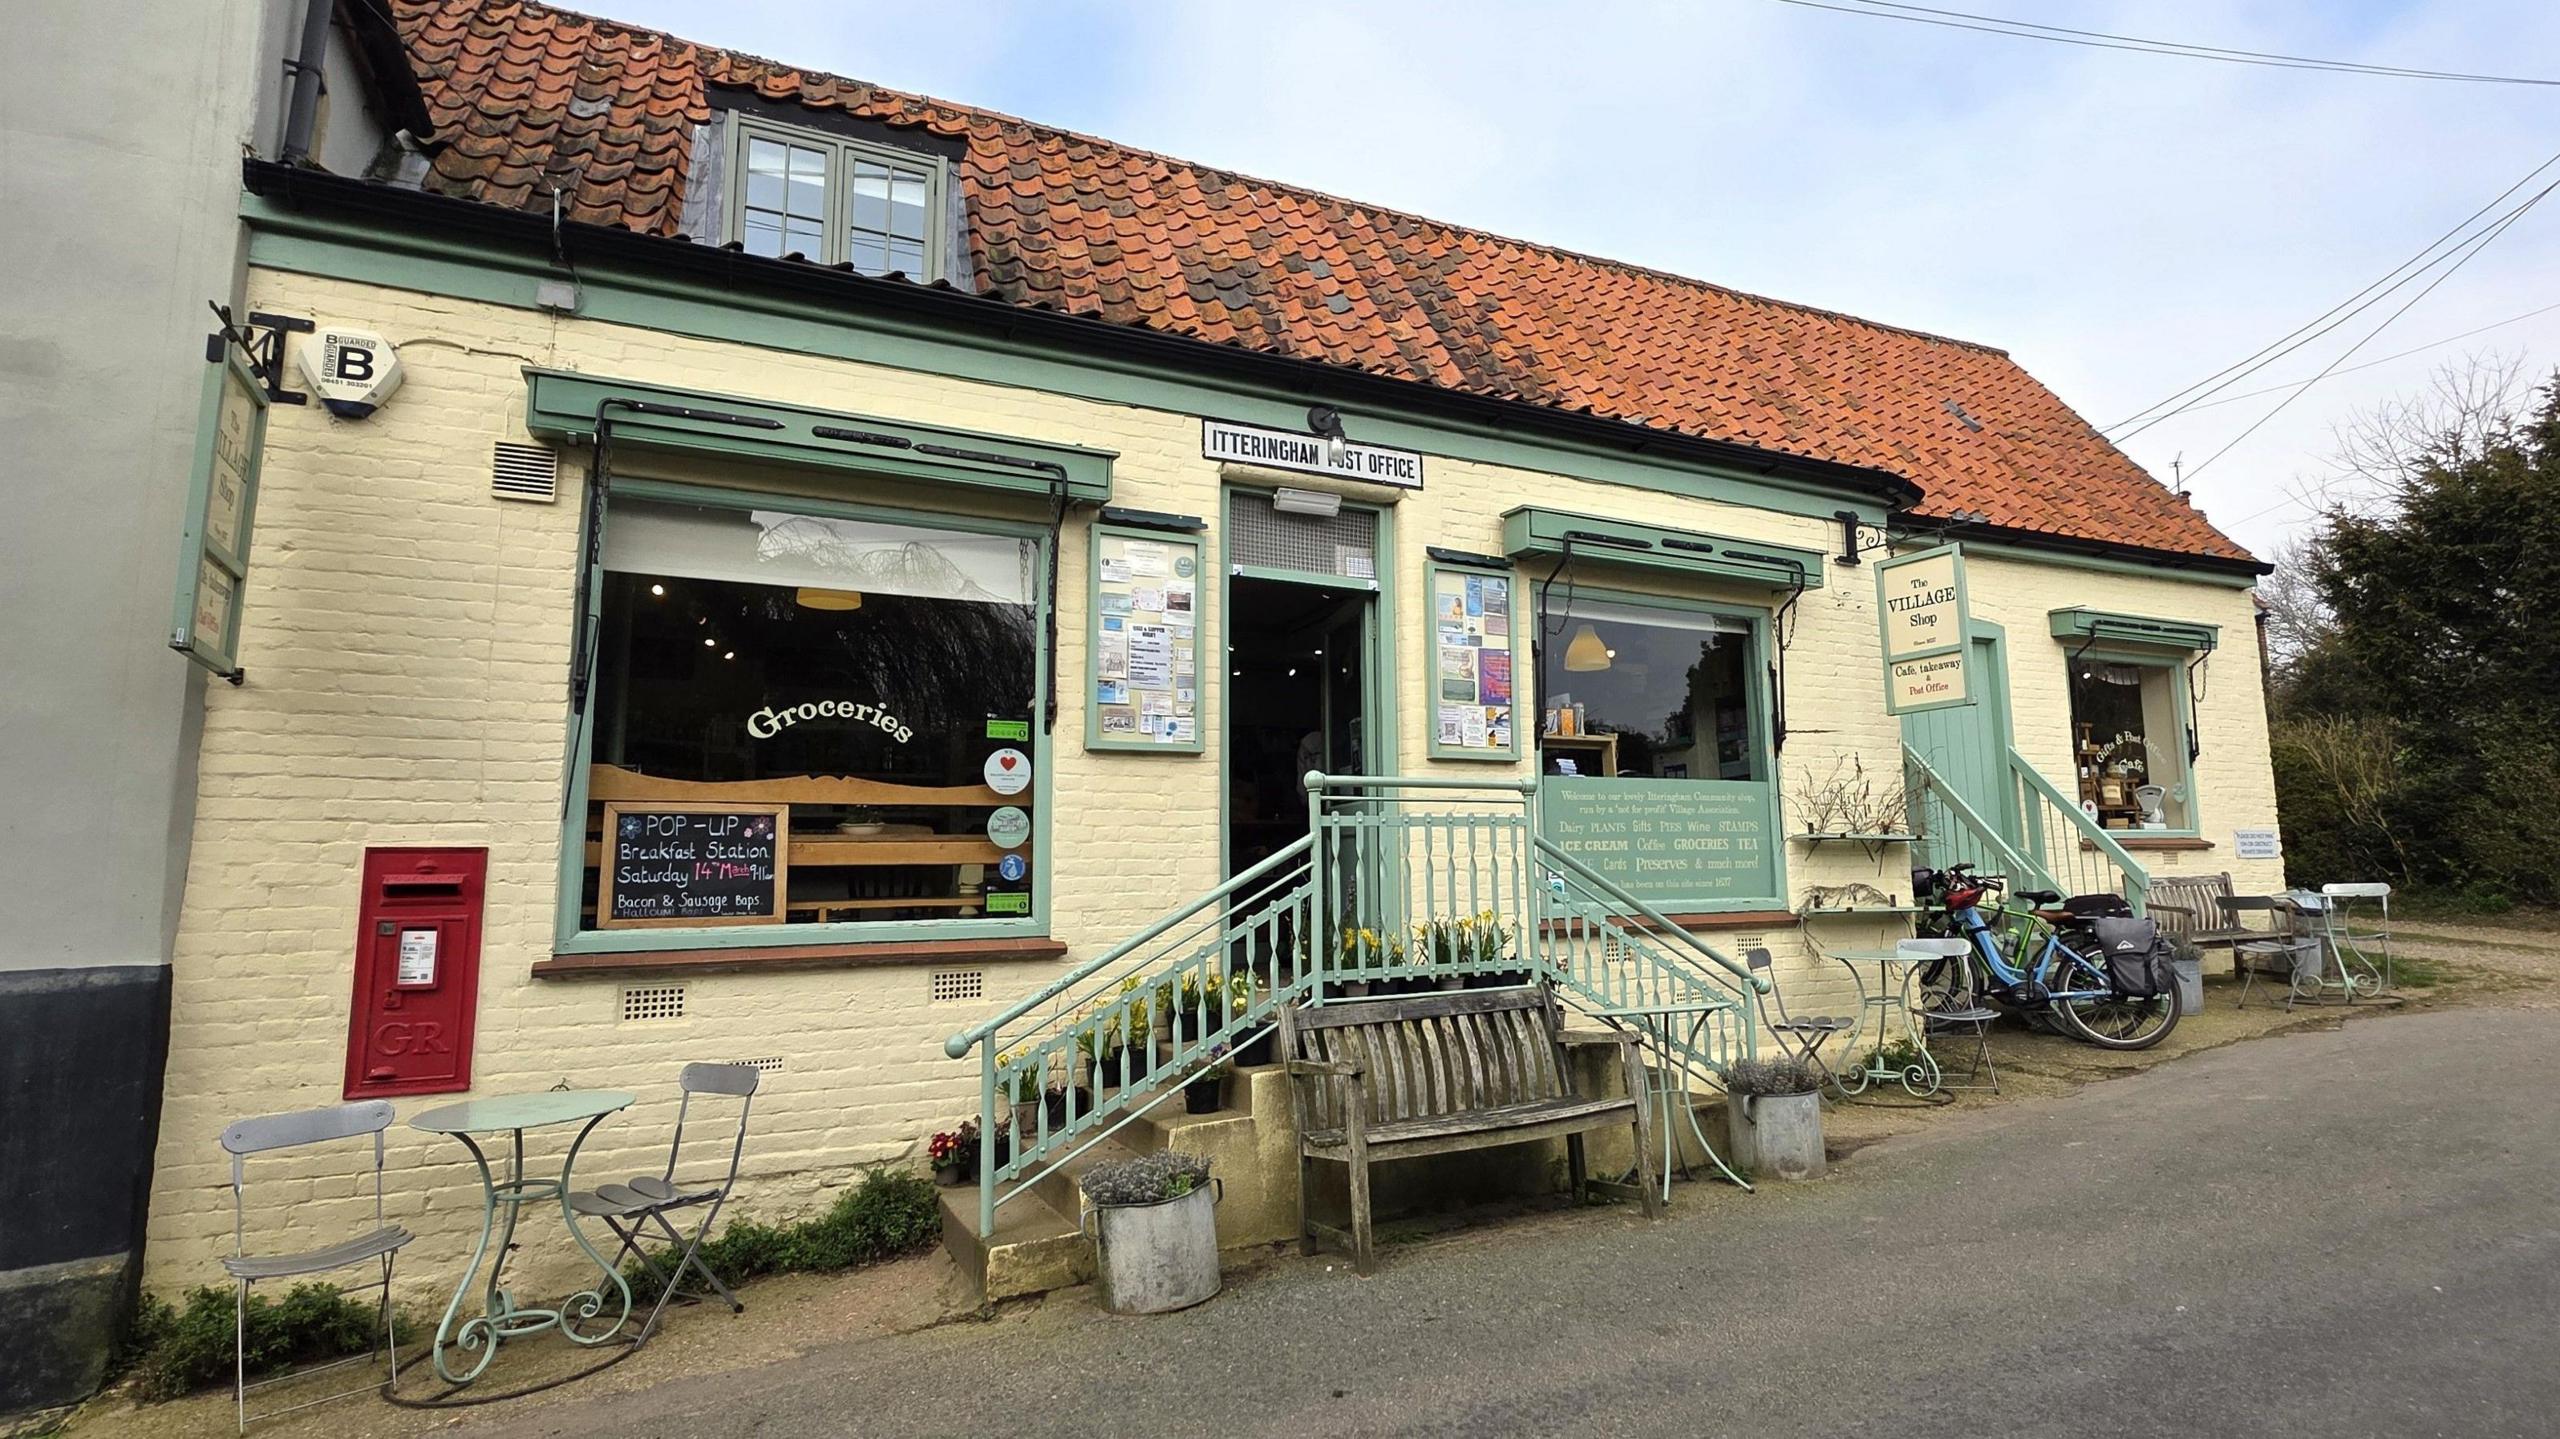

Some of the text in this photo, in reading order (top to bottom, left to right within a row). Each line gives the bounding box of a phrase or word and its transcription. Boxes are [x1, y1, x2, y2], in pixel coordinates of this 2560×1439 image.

[338, 336, 377, 349] GUARDED
[322, 344, 337, 377] GUARDED
[336, 345, 374, 381] B
[218, 429, 249, 484] ILLAGE
[1212, 429, 1319, 466] ITTERINGHAM
[1368, 453, 1415, 480] OFFICE
[1910, 579, 1928, 589] The
[1888, 586, 1956, 613] VILLAGE
[1909, 612, 1937, 627] Shop
[1920, 659, 1961, 674] takeaway
[1909, 683, 1949, 696] Post Office
[747, 700, 914, 744] Groceries
[2096, 742, 2115, 763] Gifts
[2115, 733, 2124, 745] &
[2124, 730, 2142, 744] Post
[1560, 789, 1595, 801] Welcome
[1597, 791, 1606, 801] to
[1595, 803, 1606, 816] by
[1631, 804, 1642, 814] for
[1669, 804, 1696, 816] Village
[646, 815, 687, 836] POP
[1560, 820, 1759, 835] Dairy PLANTS Gifts PIES Wine STAMPS
[620, 841, 697, 860] Breakfast
[1560, 838, 1759, 852] ICE CREAM Coffee GROCERIES TEA
[1603, 858, 1628, 870] Cards
[1636, 857, 1689, 873] Preserves
[1695, 858, 1703, 869] &
[1707, 857, 1732, 869] much
[617, 862, 689, 889] Saturday
[618, 894, 656, 909] Bacon
[662, 894, 674, 907] &
[678, 892, 728, 913] Sausage
[373, 1022, 451, 1057] GR
